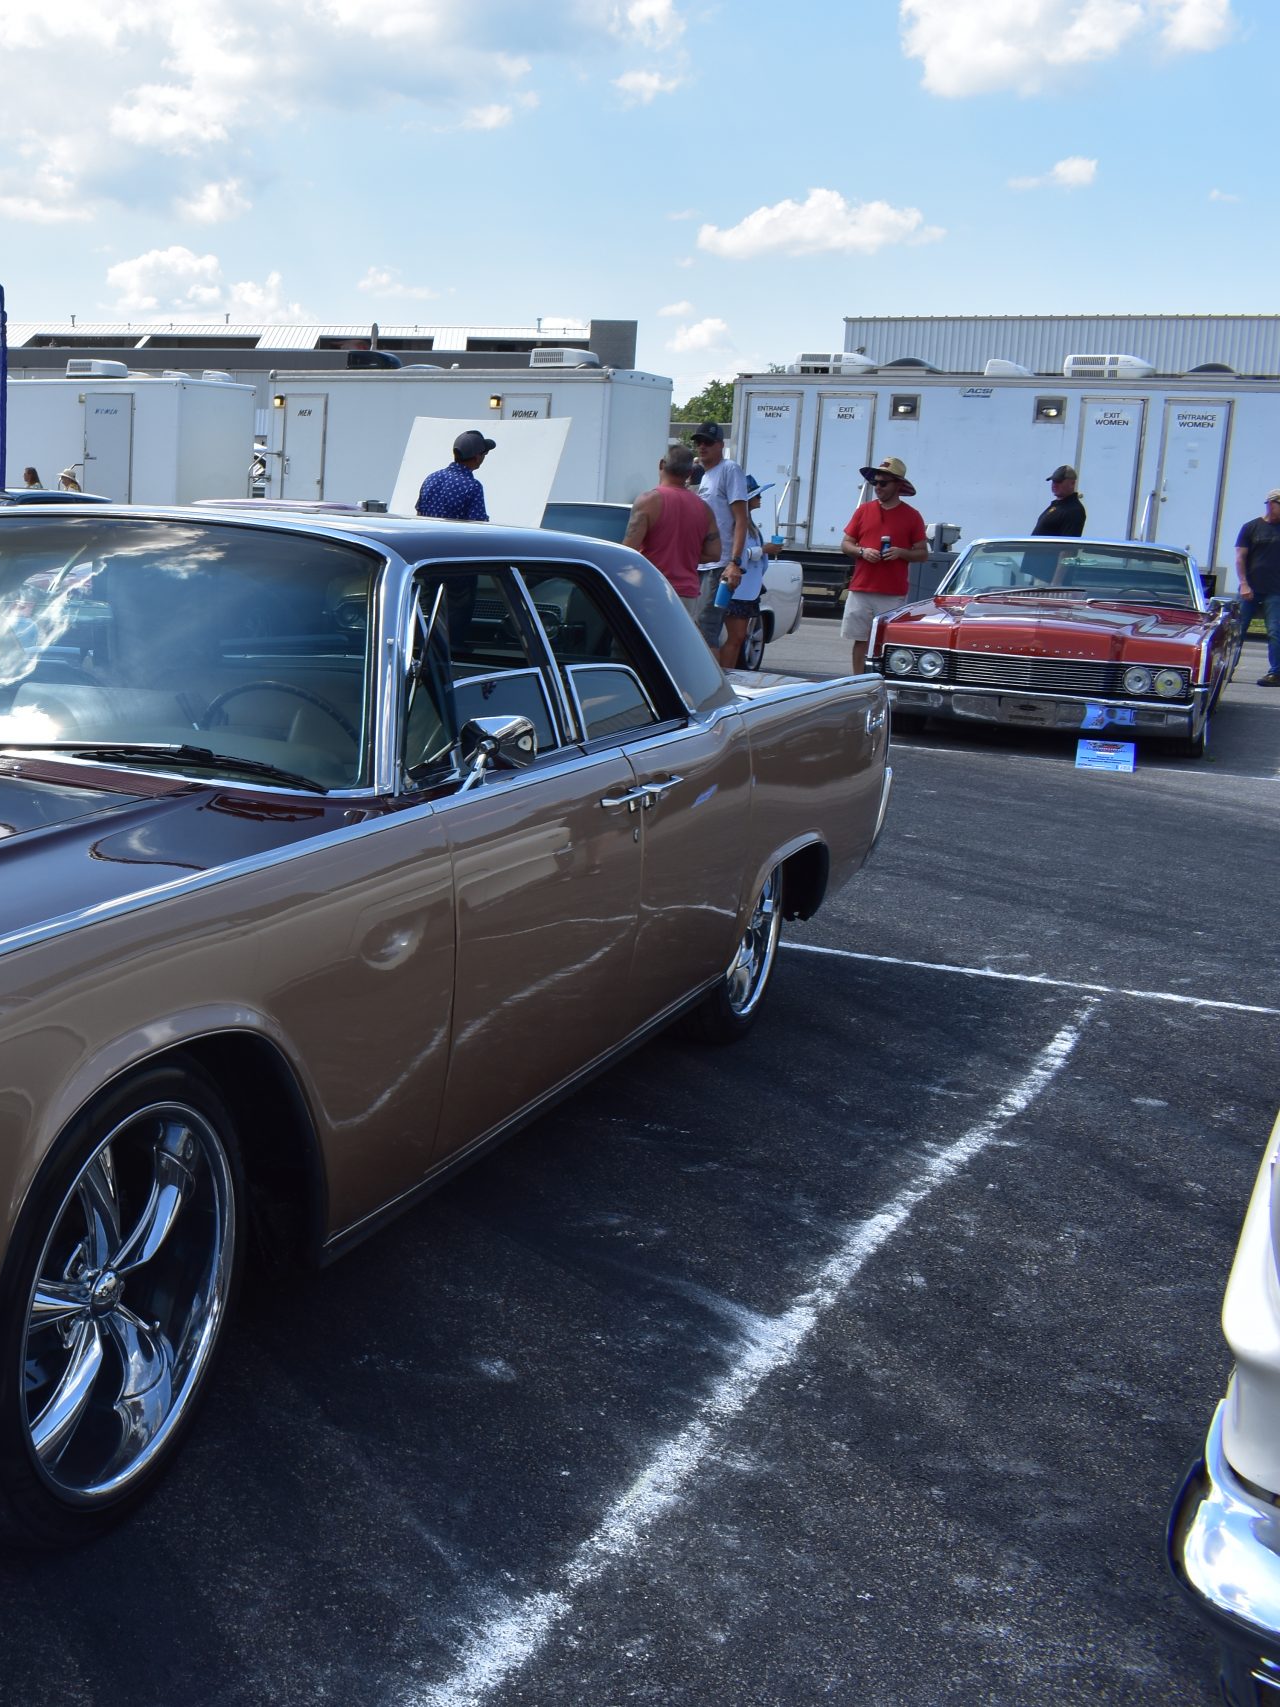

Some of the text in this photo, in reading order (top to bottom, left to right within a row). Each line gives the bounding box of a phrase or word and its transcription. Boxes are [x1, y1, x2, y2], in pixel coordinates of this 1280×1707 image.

[297, 409, 313, 417] MEN
[511, 410, 539, 418] WOMEN
[1177, 413, 1217, 421] ENTRANCE
